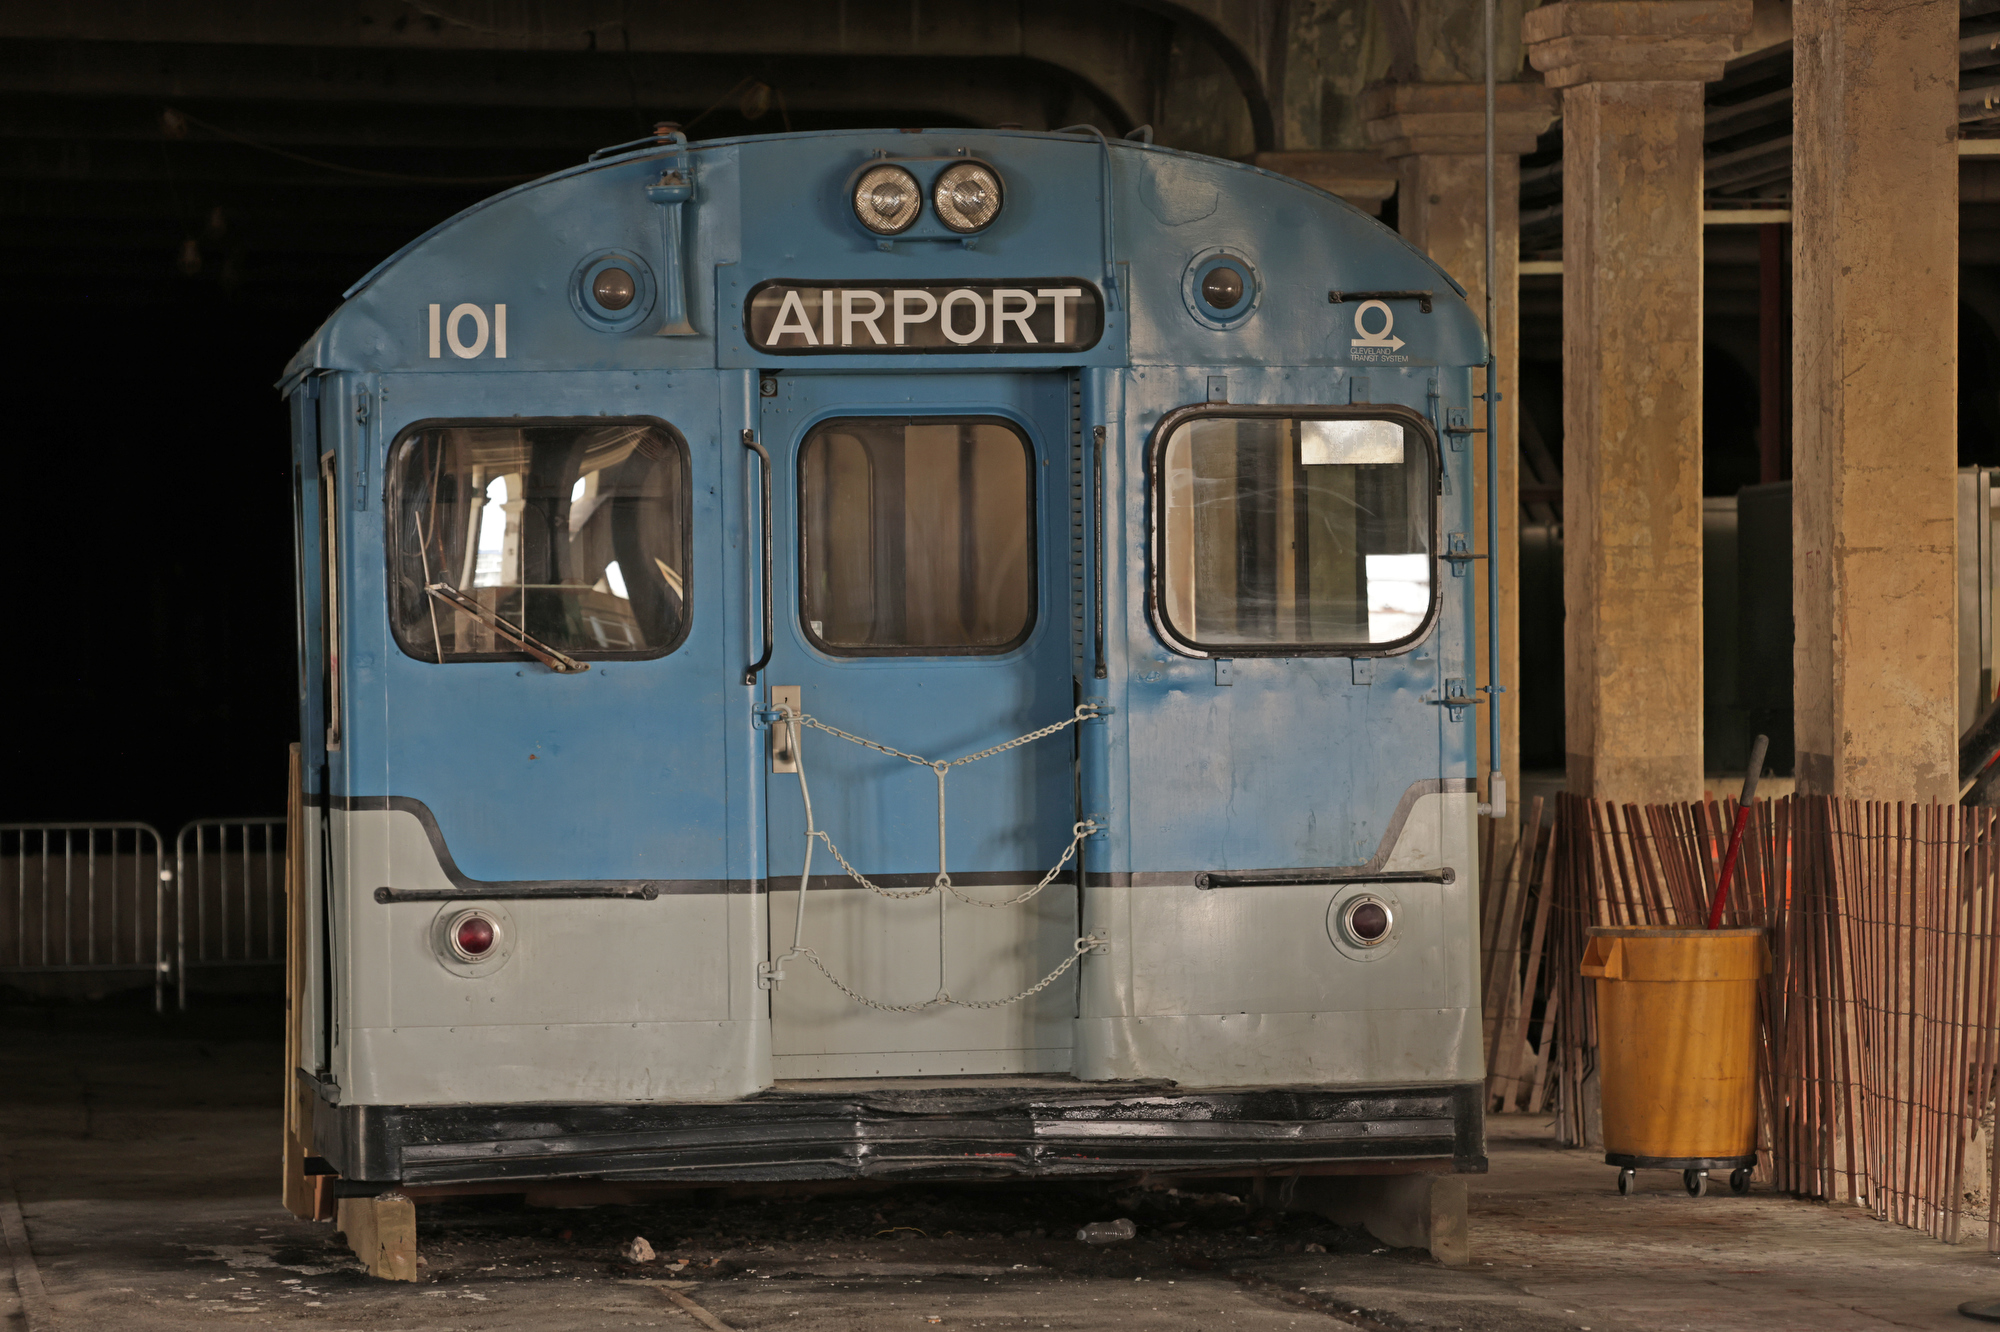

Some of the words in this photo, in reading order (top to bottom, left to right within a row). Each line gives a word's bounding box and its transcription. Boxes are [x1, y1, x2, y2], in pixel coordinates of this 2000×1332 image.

[429, 303, 507, 359] 101
[766, 289, 1081, 346] AIRPORT
[1350, 347, 1391, 355] CLEVELAND
